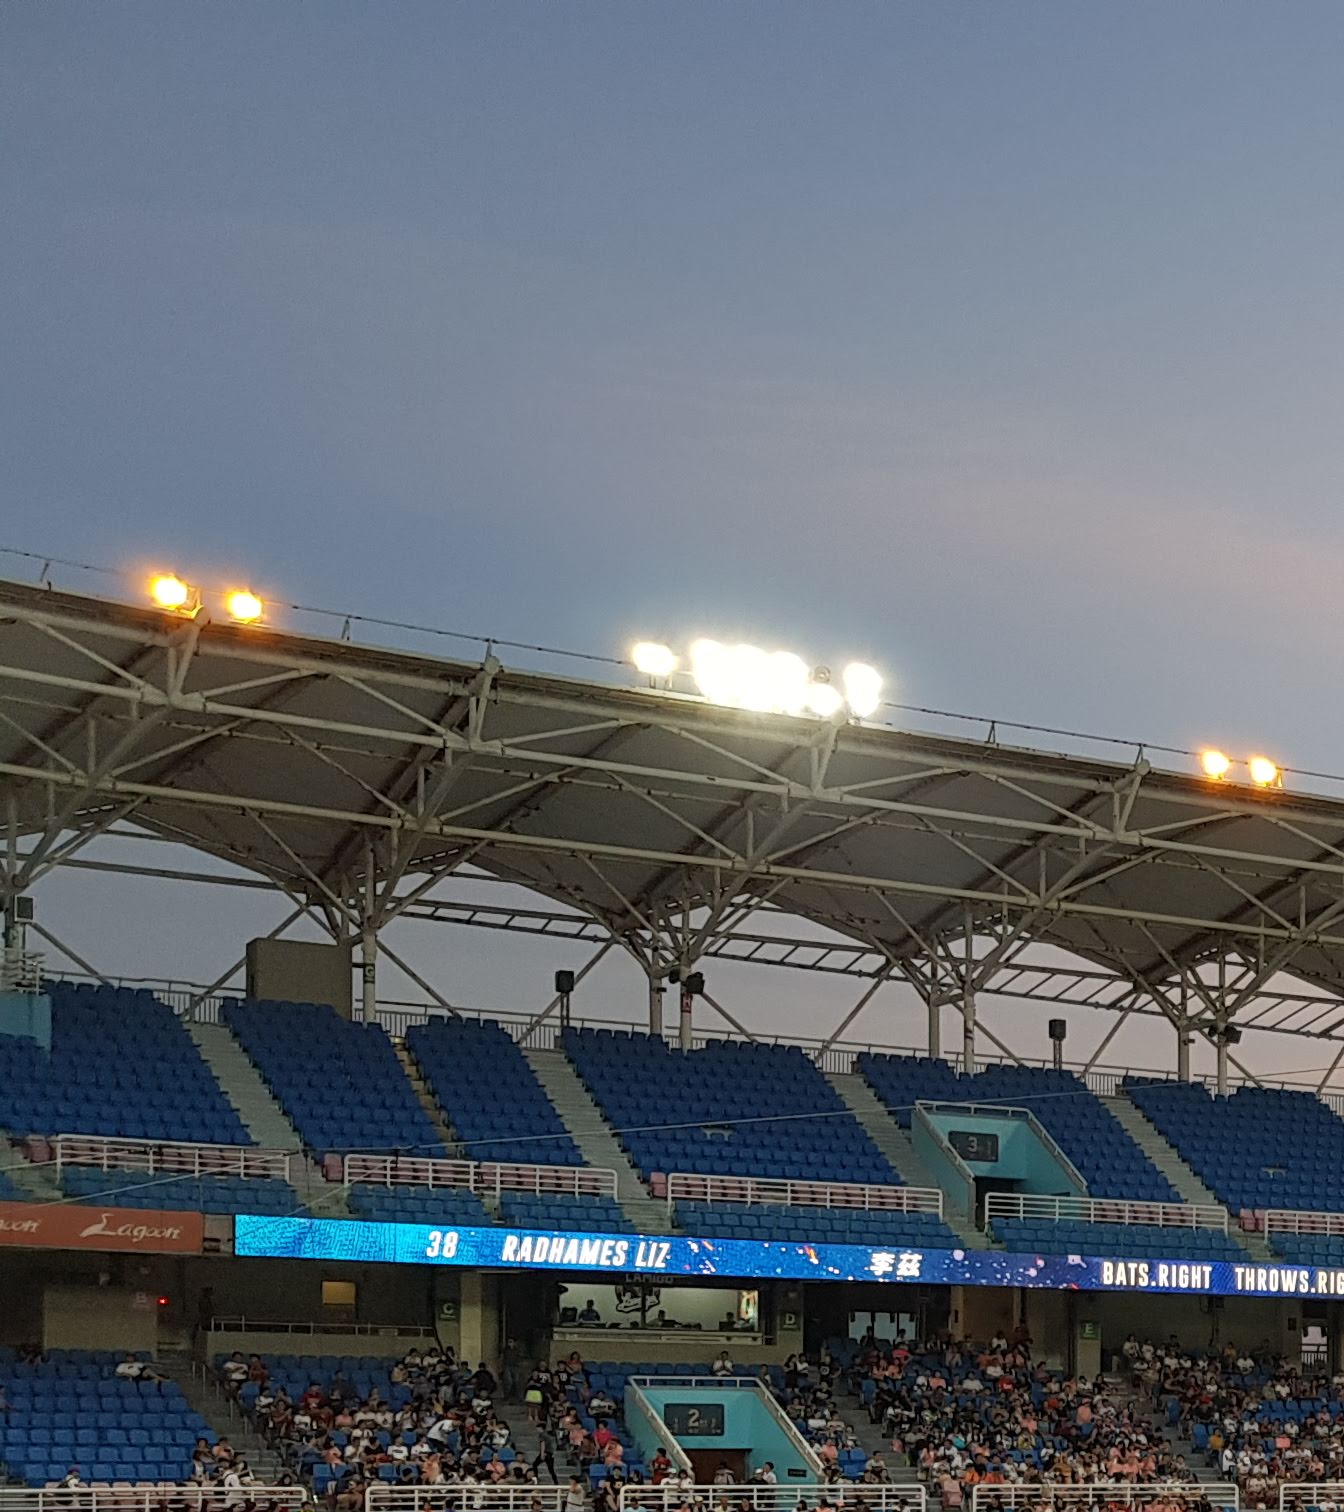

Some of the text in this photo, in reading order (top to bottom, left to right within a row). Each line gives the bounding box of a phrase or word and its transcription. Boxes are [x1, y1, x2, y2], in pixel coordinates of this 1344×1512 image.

[968, 1136, 978, 1151] 3
[80, 1212, 183, 1242] Lagoon
[426, 1231, 671, 1268] 38 RADHAMES LIZ
[1102, 1261, 1213, 1290] BATS.RIGHT
[688, 1408, 700, 1426] 2
